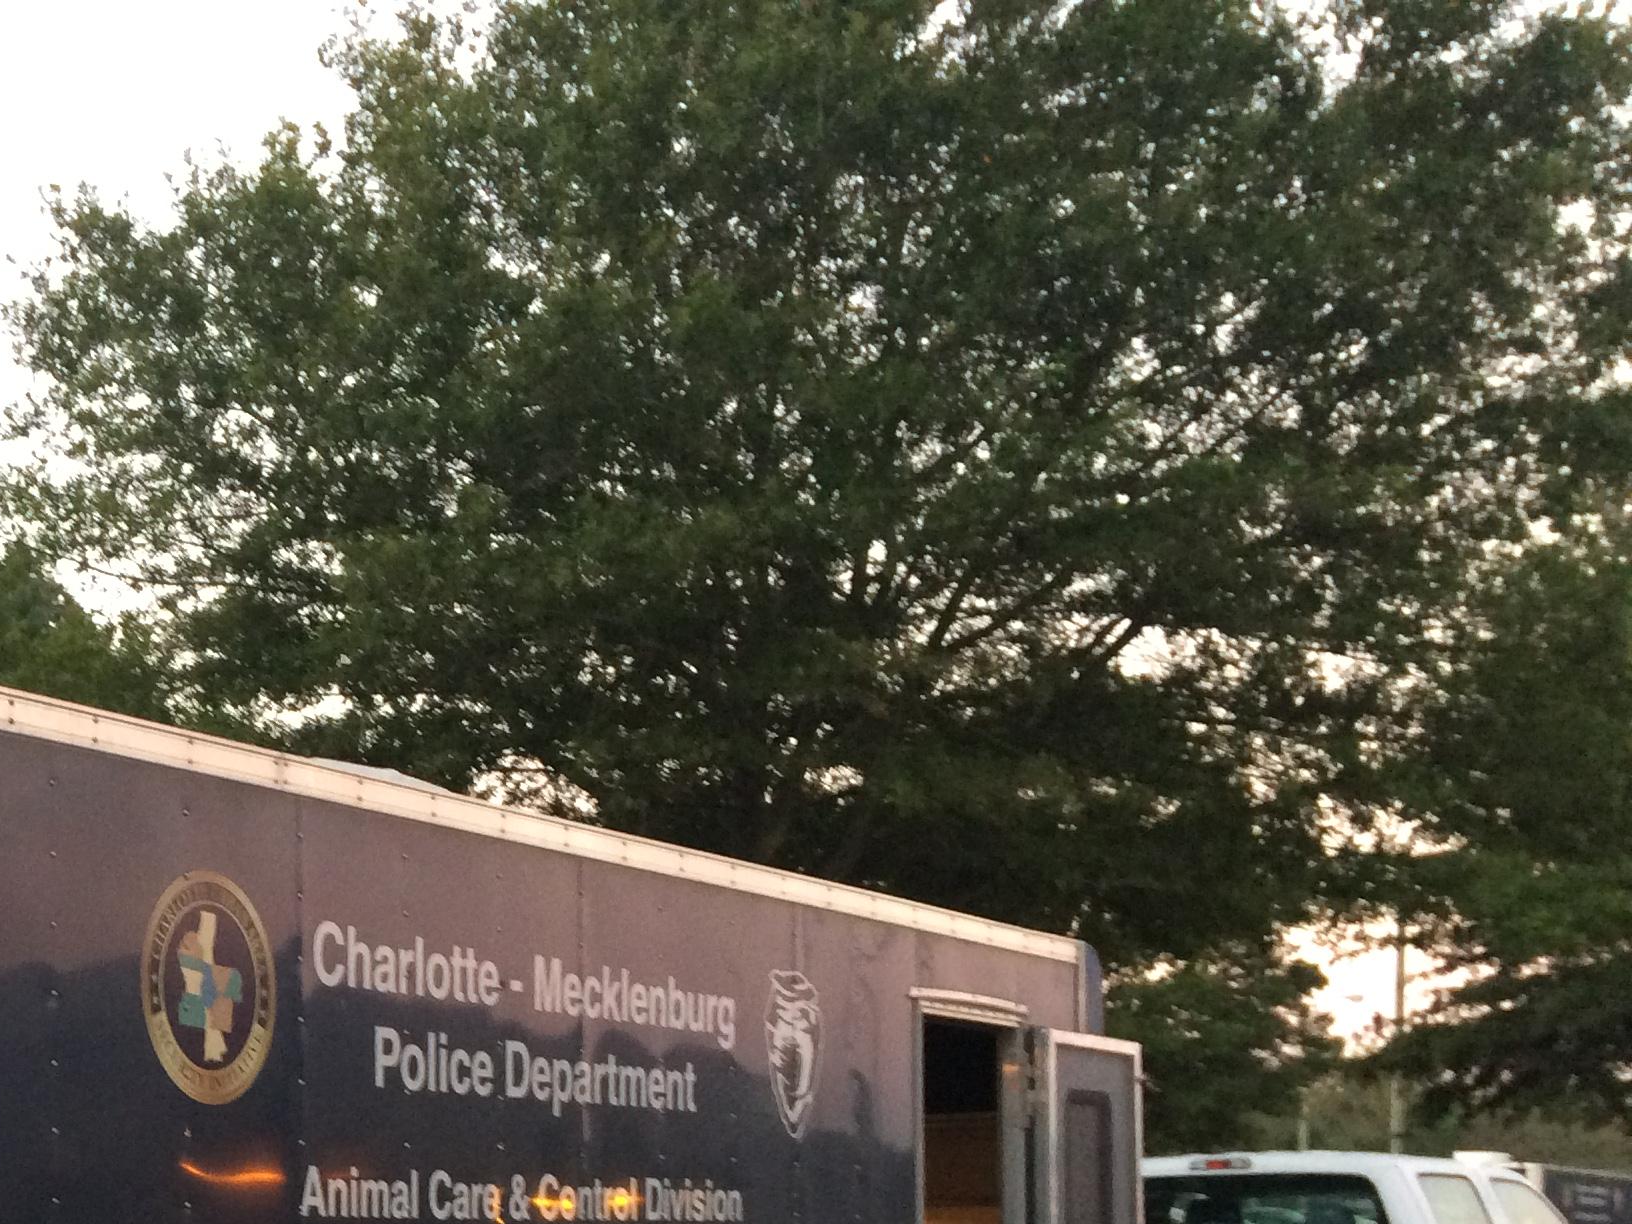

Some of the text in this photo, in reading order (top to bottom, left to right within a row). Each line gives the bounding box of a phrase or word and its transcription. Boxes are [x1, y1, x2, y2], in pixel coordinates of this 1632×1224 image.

[312, 920, 501, 1006] Charlotte
[533, 954, 736, 1050] Mecklenburg
[374, 1025, 697, 1117] Police Department
[299, 1164, 743, 1222] Animal Care & Control Division
